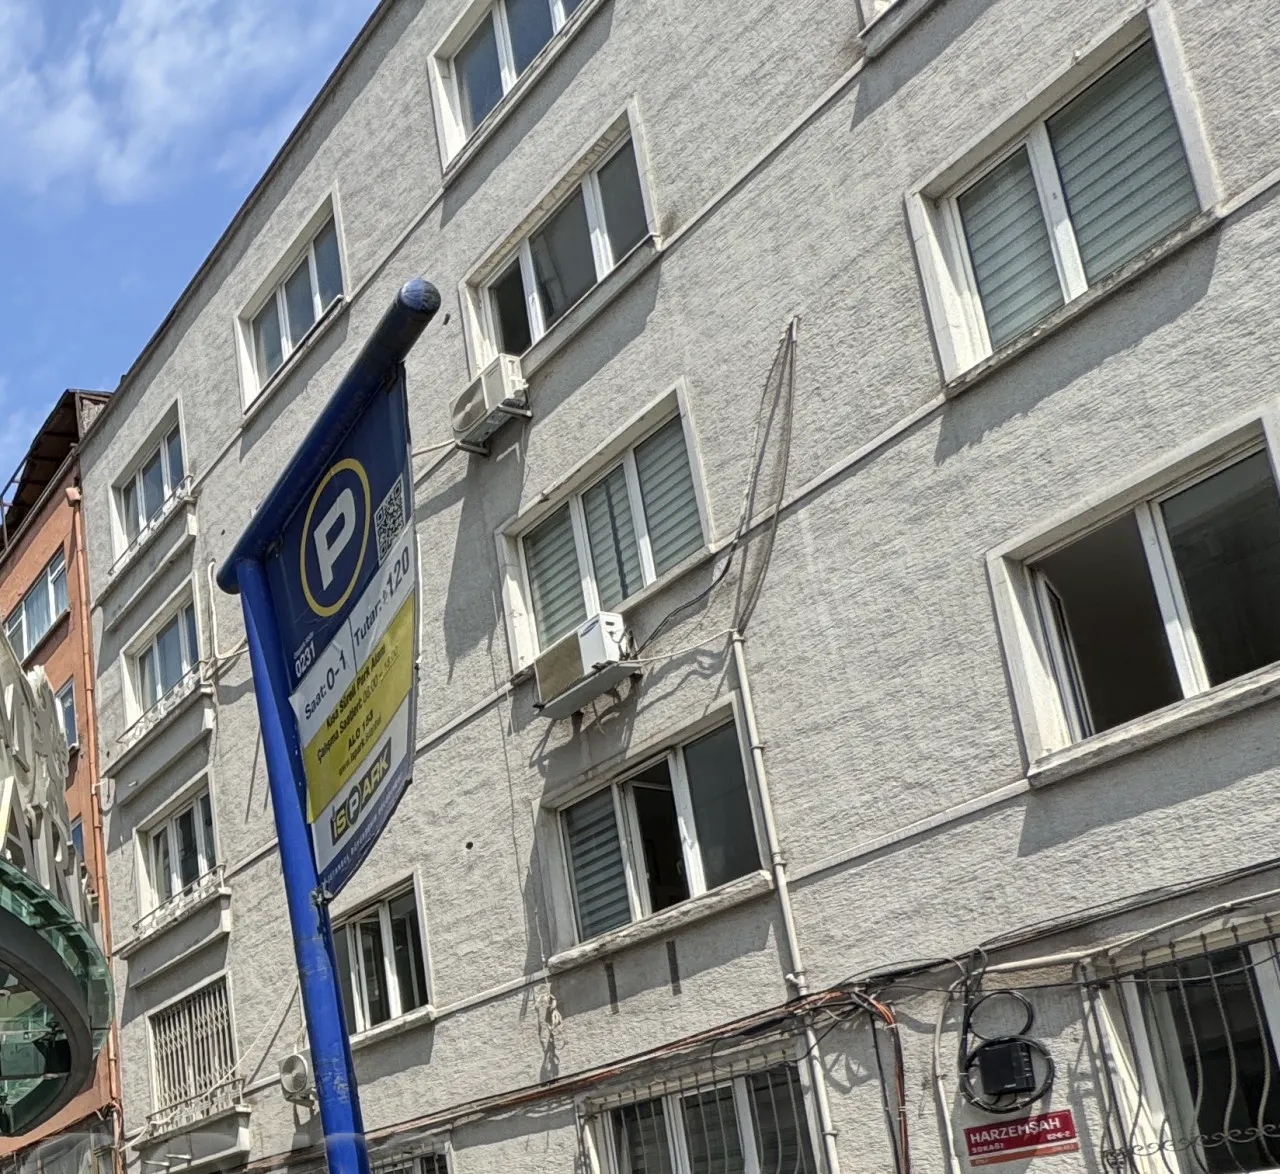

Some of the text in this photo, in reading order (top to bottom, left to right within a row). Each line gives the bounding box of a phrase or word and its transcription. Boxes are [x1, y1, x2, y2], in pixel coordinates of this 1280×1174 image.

[313, 488, 356, 591] P
[295, 641, 316, 678] 0231
[304, 684, 327, 720] Saat:
[354, 601, 383, 646] Tutar:
[970, 1117, 1060, 1144] HARZEMŞAH
